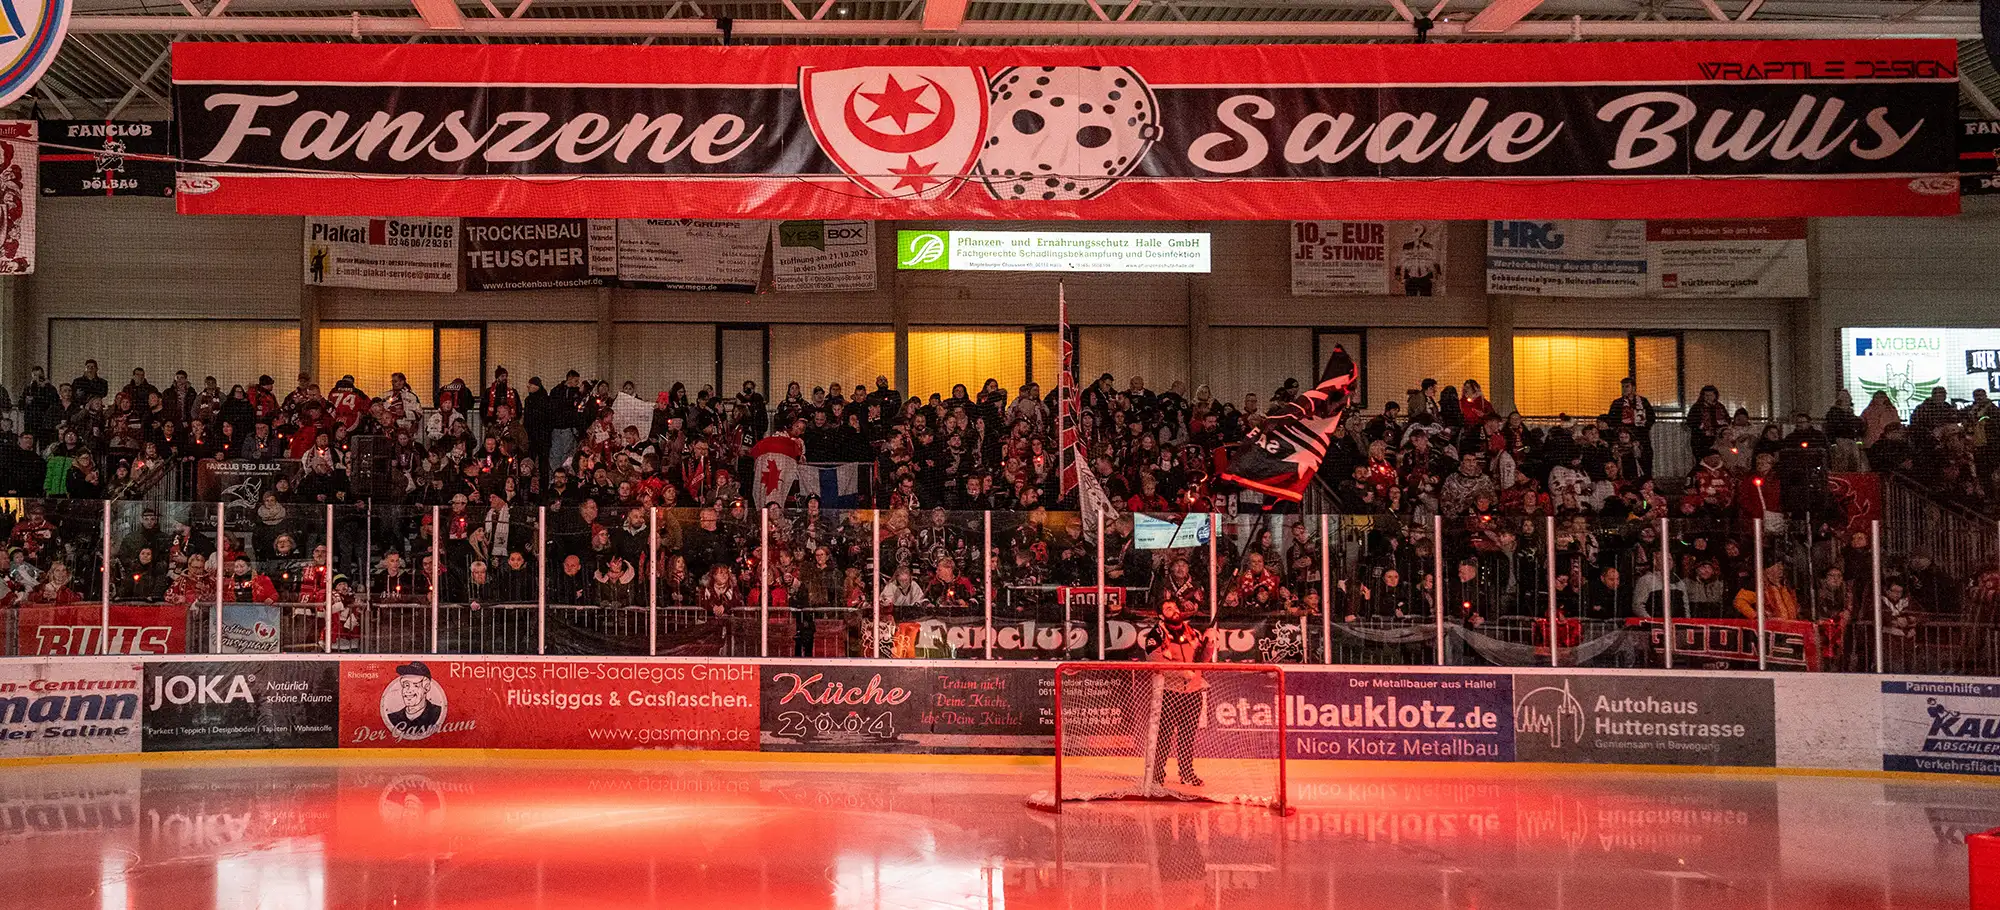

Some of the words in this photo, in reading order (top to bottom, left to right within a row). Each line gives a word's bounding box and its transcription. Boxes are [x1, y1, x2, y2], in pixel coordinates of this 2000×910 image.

[1855, 60, 1957, 79] DESIGN
[67, 124, 153, 138] FANCLUB
[204, 90, 765, 164] Fanszene
[1187, 94, 1564, 173] Saale
[1597, 92, 1924, 169] Bulls
[82, 177, 138, 189] DÖLBAU
[178, 179, 214, 189] ACS
[647, 218, 680, 226] MEGA
[693, 220, 741, 229] GRUPPE
[312, 223, 366, 243] Plakat
[388, 220, 453, 239] Service
[467, 223, 581, 242] TROCKENBAU
[785, 230, 820, 240] YES
[828, 228, 863, 239] BOX
[1342, 222, 1385, 244] EUR
[1493, 221, 1565, 250] HRG
[958, 237, 1005, 247] Pflanzen-
[1011, 238, 1031, 247] und
[1037, 238, 1129, 249] Ernährungsschutz
[1136, 238, 1162, 247] Halle
[1168, 239, 1200, 248] GmbH
[467, 247, 584, 269] TEUSCHER
[829, 249, 869, 259] 21.10.2020
[956, 249, 1017, 259] Fachgerechte
[1126, 250, 1143, 258] und
[1145, 250, 1201, 258] Desinfektion
[1294, 245, 1314, 260] JE
[1322, 245, 1385, 261] STUNDE
[363, 269, 452, 280] plakat-service@gmx.de
[802, 264, 816, 272] den
[482, 277, 604, 290] www.trockenbau-teuscher.de
[667, 283, 718, 291] www.mega.de
[1876, 337, 1941, 350] MOBAU
[1972, 350, 1997, 370] IHR
[332, 392, 356, 411] 74
[206, 462, 240, 471] FANCLUB
[242, 463, 257, 471] RED
[915, 619, 1089, 650] Fanclub
[347, 671, 379, 679] Rheingas
[450, 662, 537, 683] Rheingas
[543, 663, 685, 684] Halle-Saalegas
[691, 664, 754, 681] GmbH
[266, 681, 308, 691] Natürlich
[773, 673, 912, 705] Küche
[1349, 678, 1369, 688] Der
[1373, 679, 1438, 688] Metallbauer
[1441, 680, 1461, 689] aus
[1464, 680, 1497, 689] Halle!
[1905, 681, 1981, 694] Pannenhilfe
[266, 692, 298, 703] schöne
[300, 693, 333, 703] Räume
[507, 688, 603, 709] Flüssiggas
[608, 691, 621, 706] &
[628, 690, 753, 708] Gasflaschen.
[931, 693, 966, 707] Deine
[1594, 694, 1699, 715] Autohaus
[941, 711, 975, 725] Deine
[1040, 708, 1054, 716] Tel.
[777, 711, 895, 739] 2004
[1040, 717, 1054, 725] Fax
[1595, 716, 1745, 738] Huttenstrasse
[43, 725, 129, 738] Saline
[181, 727, 206, 735] Teppich
[293, 724, 332, 732] Wohnstoffe
[351, 725, 387, 743] Der
[391, 718, 477, 743] Gasmann
[588, 727, 750, 744] www.gasmann.de
[1297, 737, 1341, 754] Nico
[1347, 738, 1397, 755] Klotz
[1403, 738, 1499, 756] Metallbau
[1595, 740, 1654, 750] Gemeinsam
[1656, 740, 1666, 750] in
[1668, 741, 1721, 753] Bewegung
